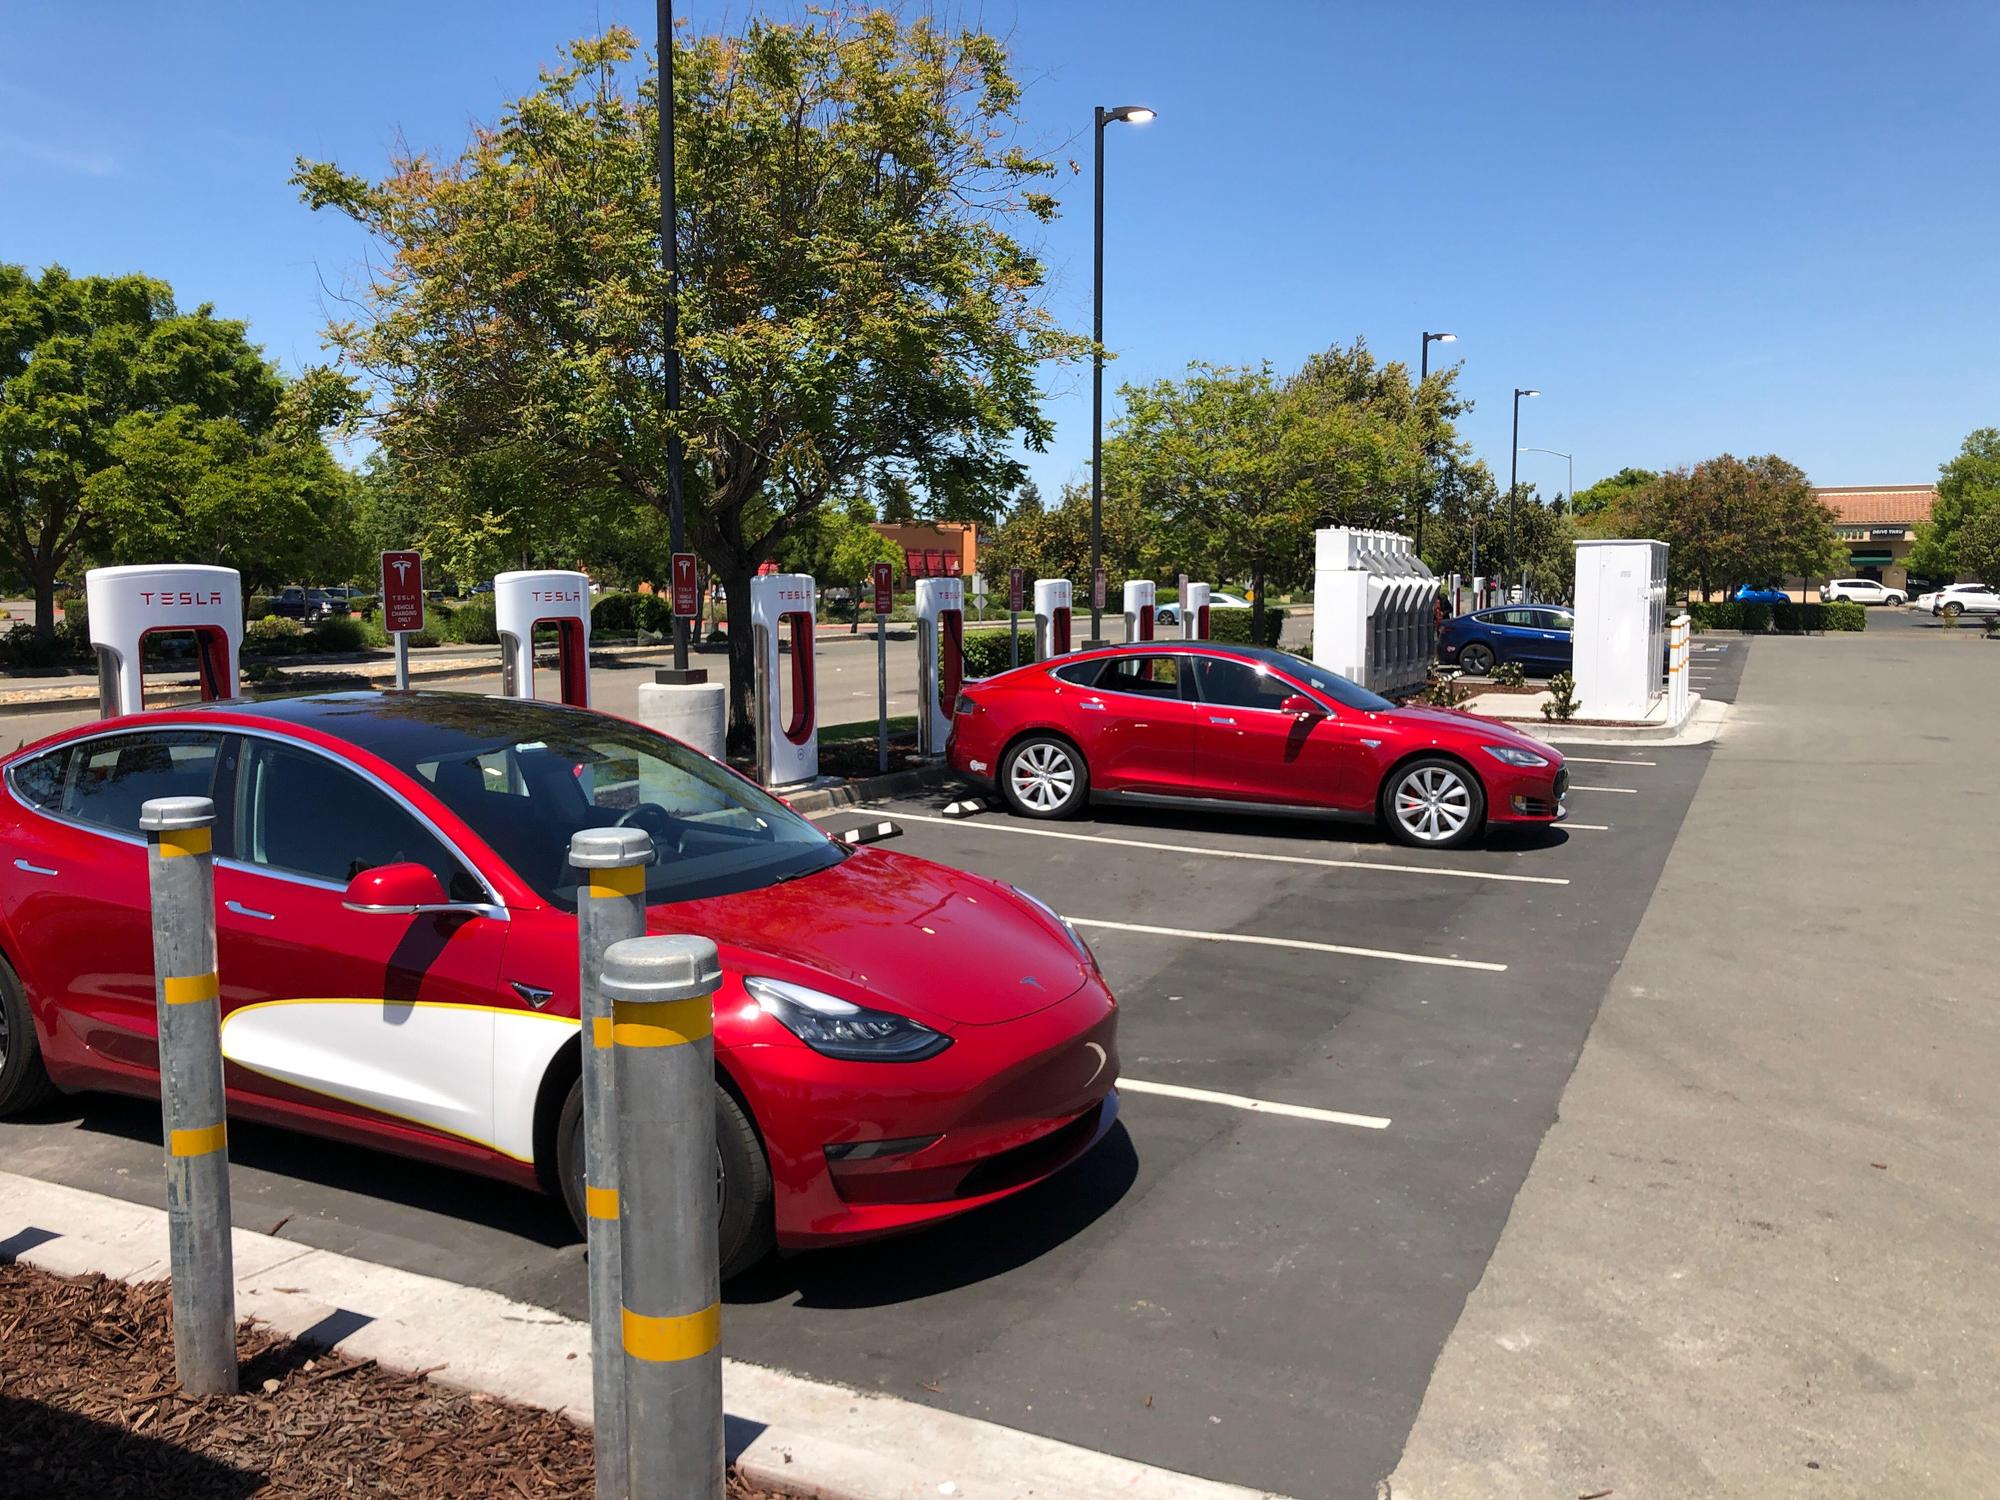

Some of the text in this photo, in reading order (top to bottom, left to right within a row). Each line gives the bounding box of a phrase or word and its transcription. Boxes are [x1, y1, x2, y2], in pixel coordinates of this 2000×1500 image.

[140, 592, 221, 605] TESLA
[531, 591, 581, 602] TESLA
[778, 590, 811, 600] TESLA
